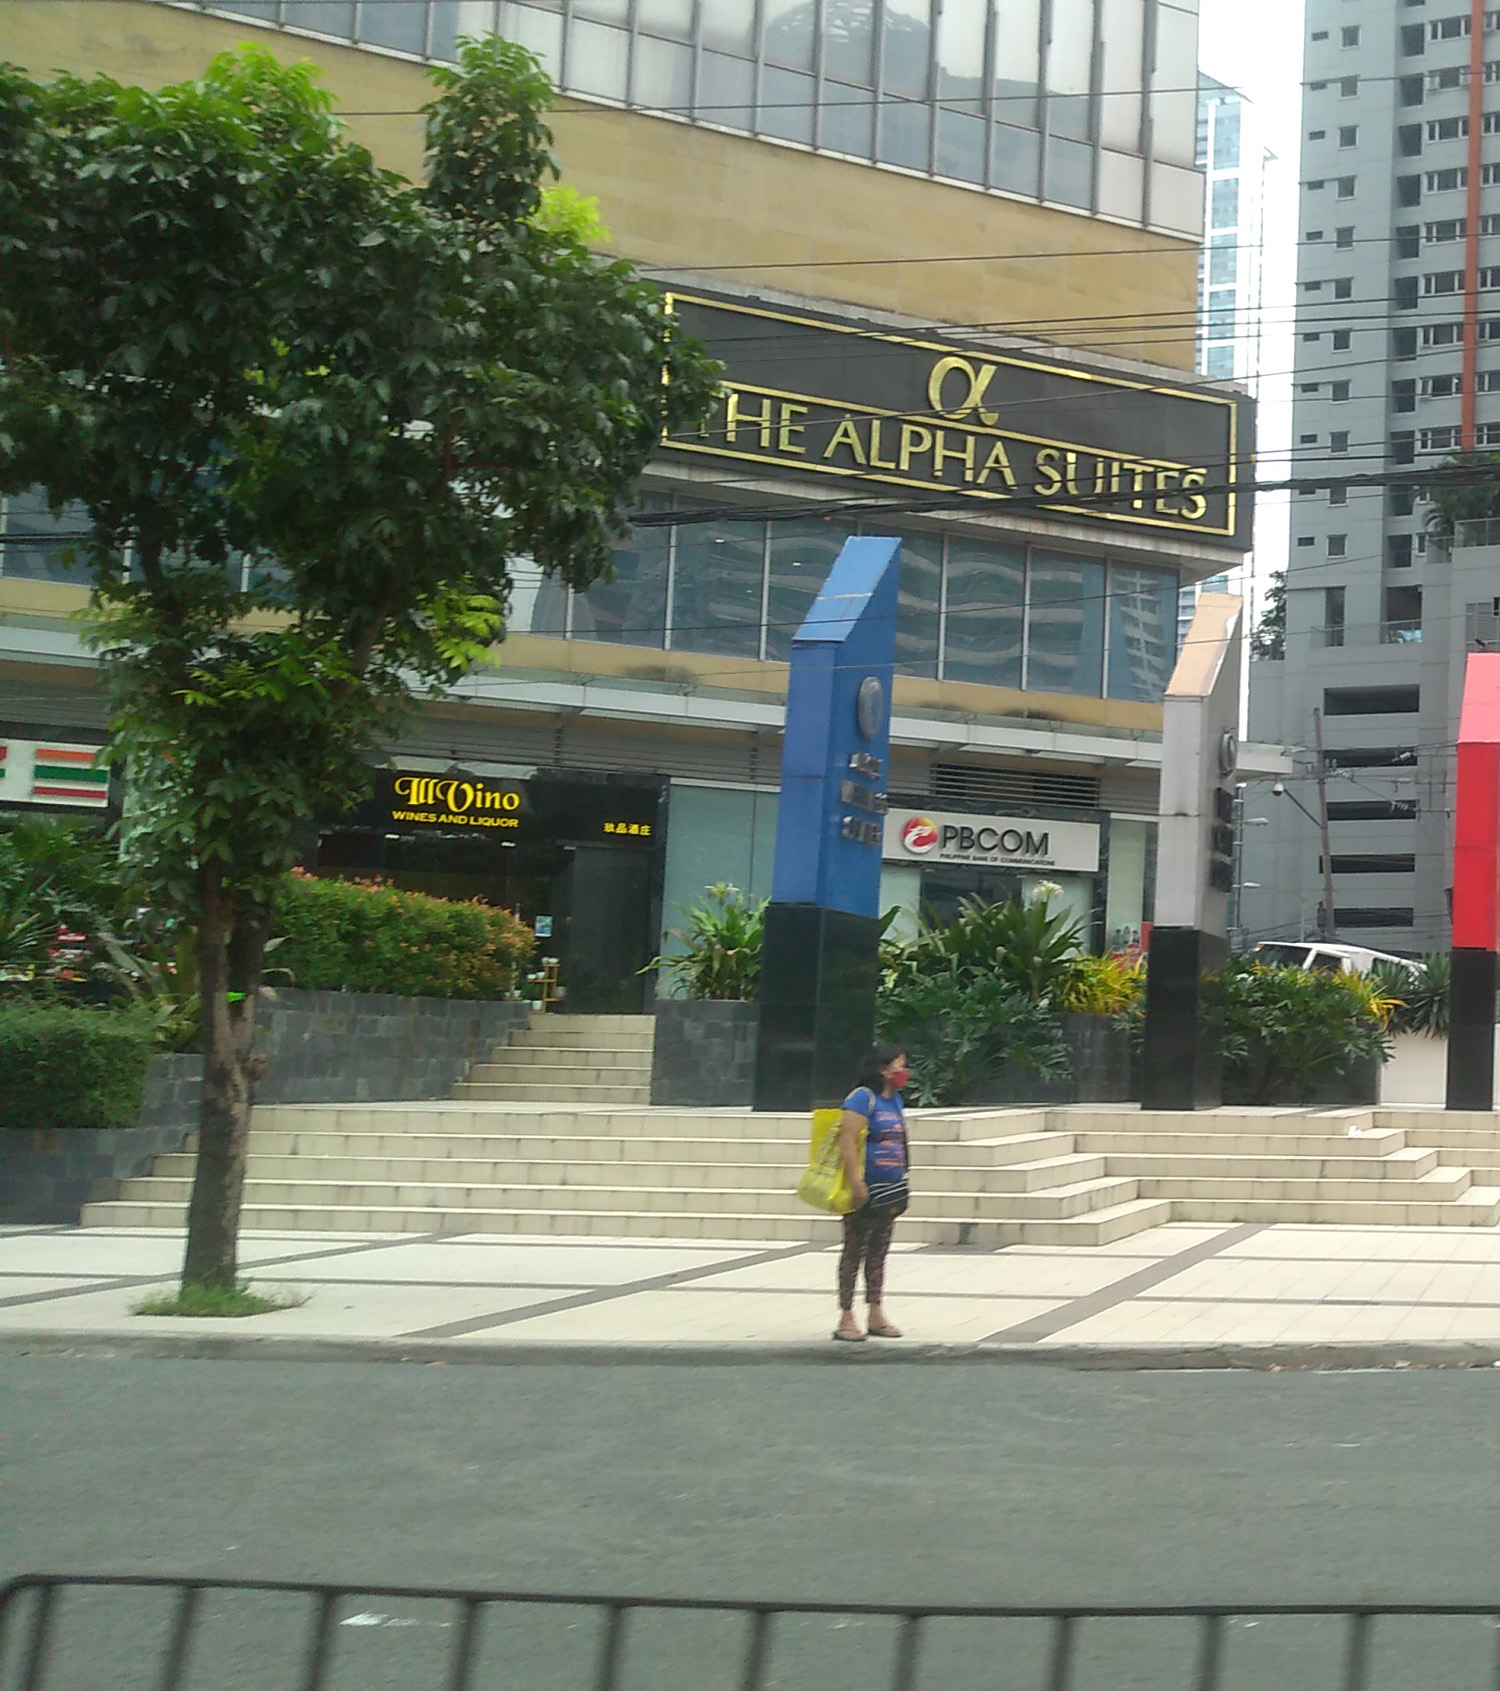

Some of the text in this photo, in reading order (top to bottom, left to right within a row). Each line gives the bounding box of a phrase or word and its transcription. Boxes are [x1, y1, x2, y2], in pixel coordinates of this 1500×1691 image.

[823, 413, 1018, 489] ALPHA
[1034, 448, 1207, 520] SUITES
[392, 810, 519, 828] WINES AND LIQUOR
[942, 824, 1050, 856] PBCOM
